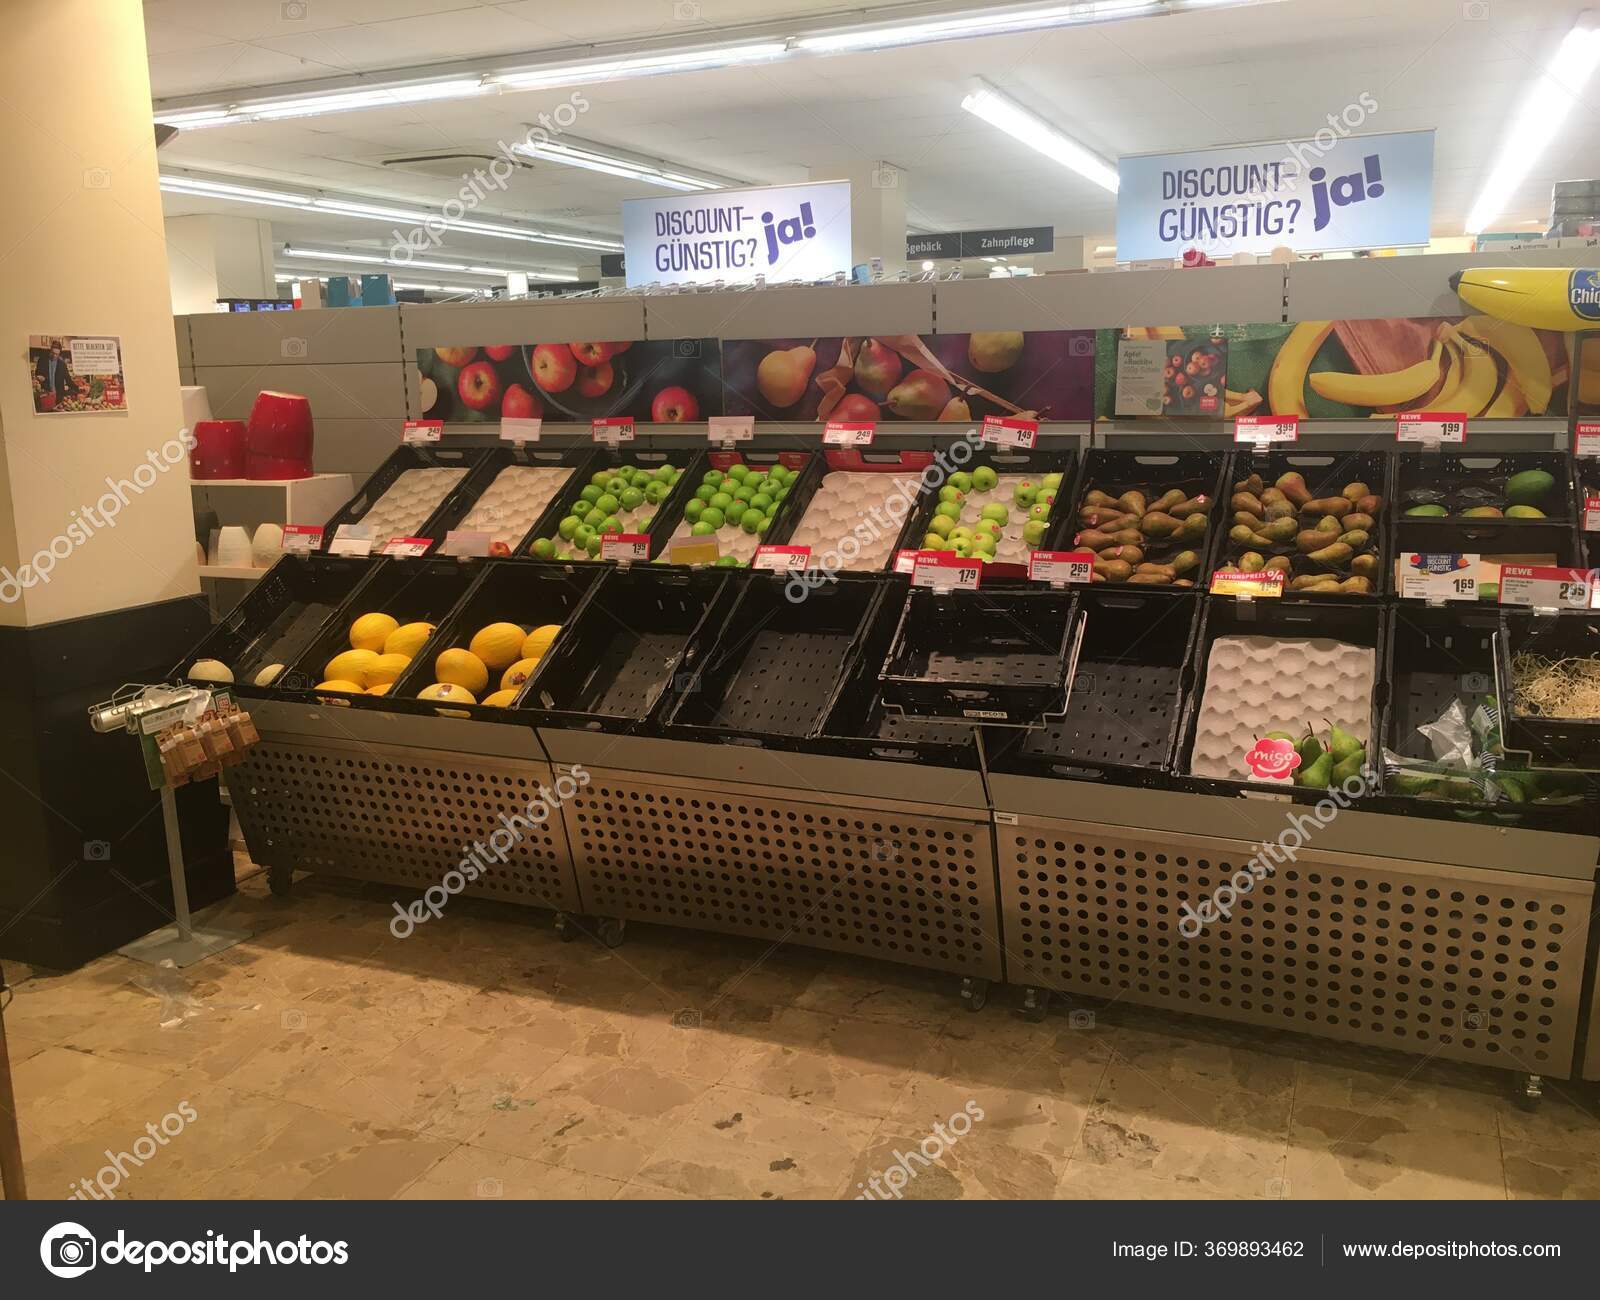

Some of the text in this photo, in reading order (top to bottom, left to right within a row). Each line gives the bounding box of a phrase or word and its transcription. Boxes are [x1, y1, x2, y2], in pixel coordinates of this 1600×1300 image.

[1162, 161, 1298, 200] DISCOUNT-
[1309, 154, 1385, 232] ja!
[655, 206, 754, 237] DISCOUNT-
[1159, 199, 1302, 242] GÜNSTIG?
[761, 201, 817, 265] ja!
[981, 236, 1035, 249] Zahnpflege
[655, 239, 757, 272] GÜNSTIG?
[1441, 422, 1460, 436] 1.99
[958, 569, 977, 583] 1.79
[1070, 563, 1089, 577] 2.69
[1504, 567, 1533, 576] REWE
[1453, 579, 1475, 593] 1.69
[1254, 750, 1294, 767] migo
